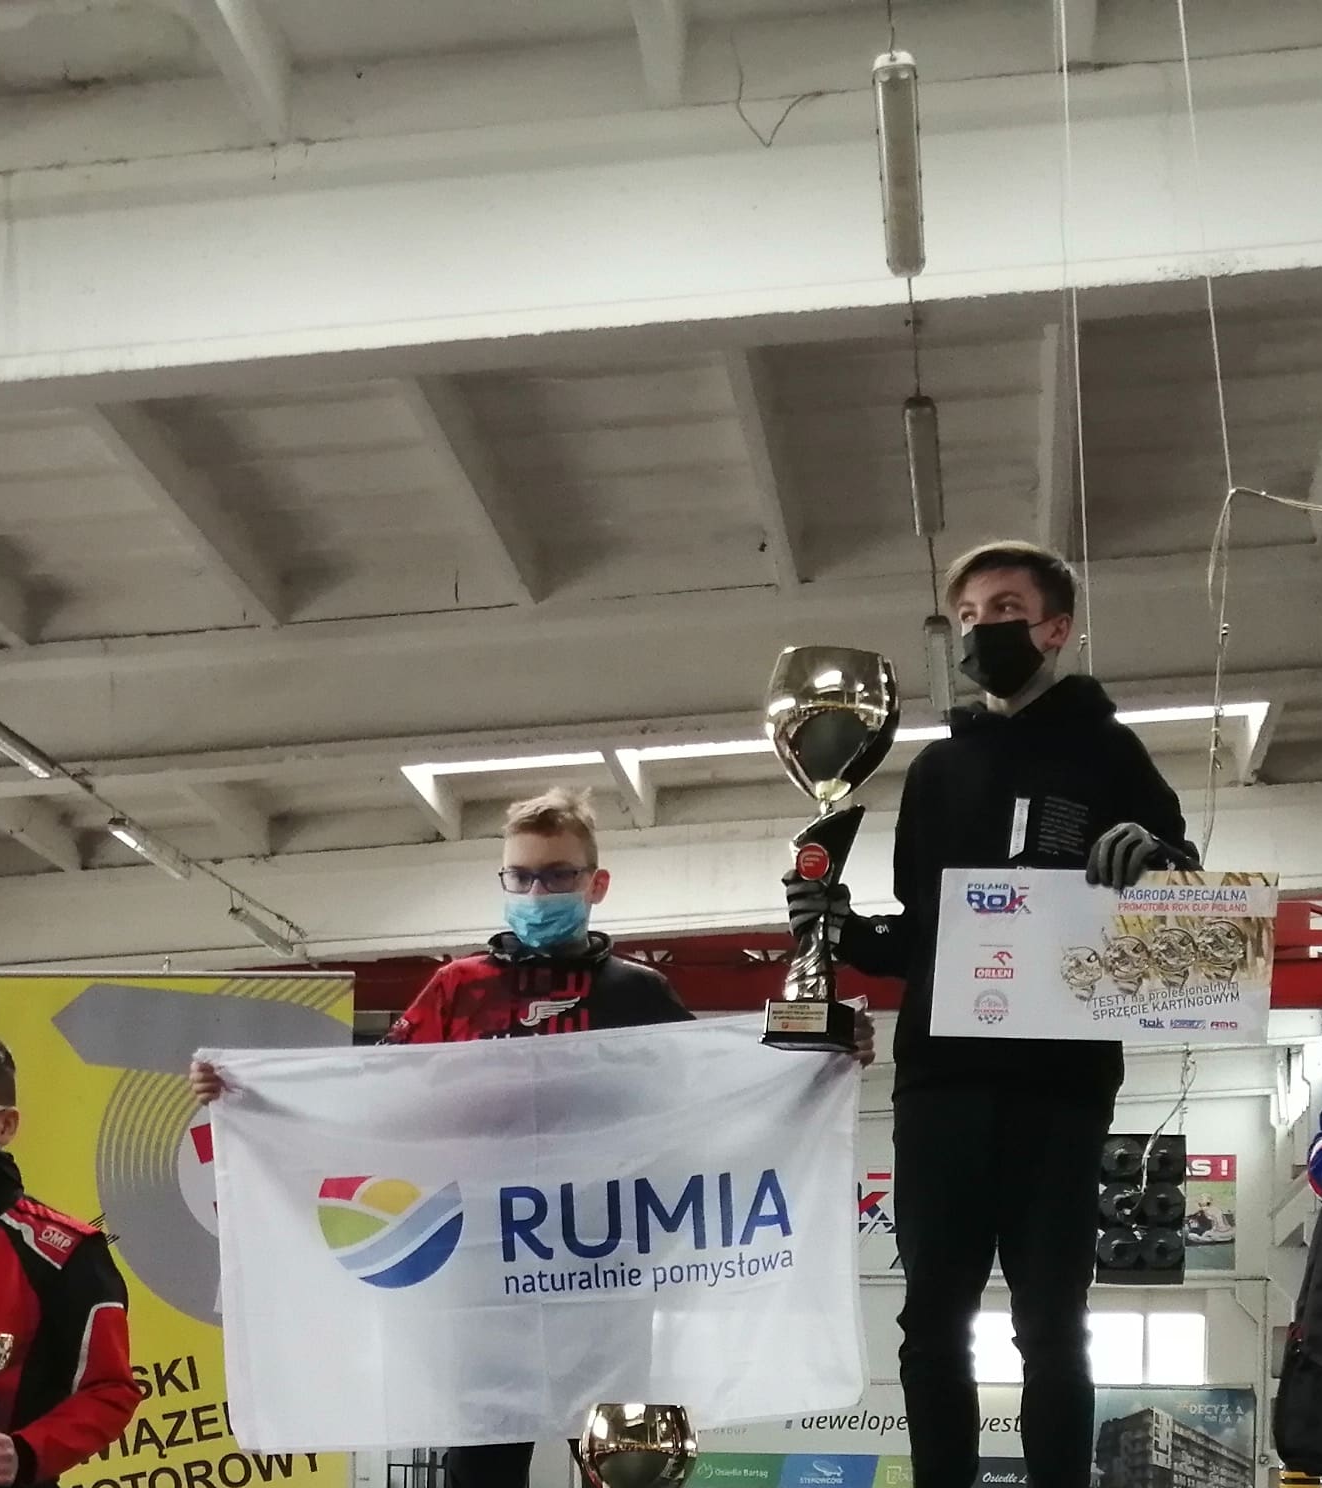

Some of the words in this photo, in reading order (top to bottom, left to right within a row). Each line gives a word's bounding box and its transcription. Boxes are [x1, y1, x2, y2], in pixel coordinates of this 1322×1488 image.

[1119, 889, 1175, 901] NAGRODA
[1179, 889, 1247, 901] SPECJALNA
[1117, 903, 1169, 913] PROMOTORA
[1172, 903, 1189, 912] ROK
[1192, 903, 1209, 912] CUP
[1211, 902, 1247, 913] POLAND
[976, 968, 1012, 978] ORLEN
[1092, 1005, 1149, 1021] SPRZĘCIE
[1152, 992, 1240, 1012] KARTINGOWYM
[499, 1168, 793, 1262] RUMIA
[40, 1229, 72, 1249] OMP
[504, 1262, 642, 1295] naturalnie
[652, 1249, 795, 1293] pomysłowa
